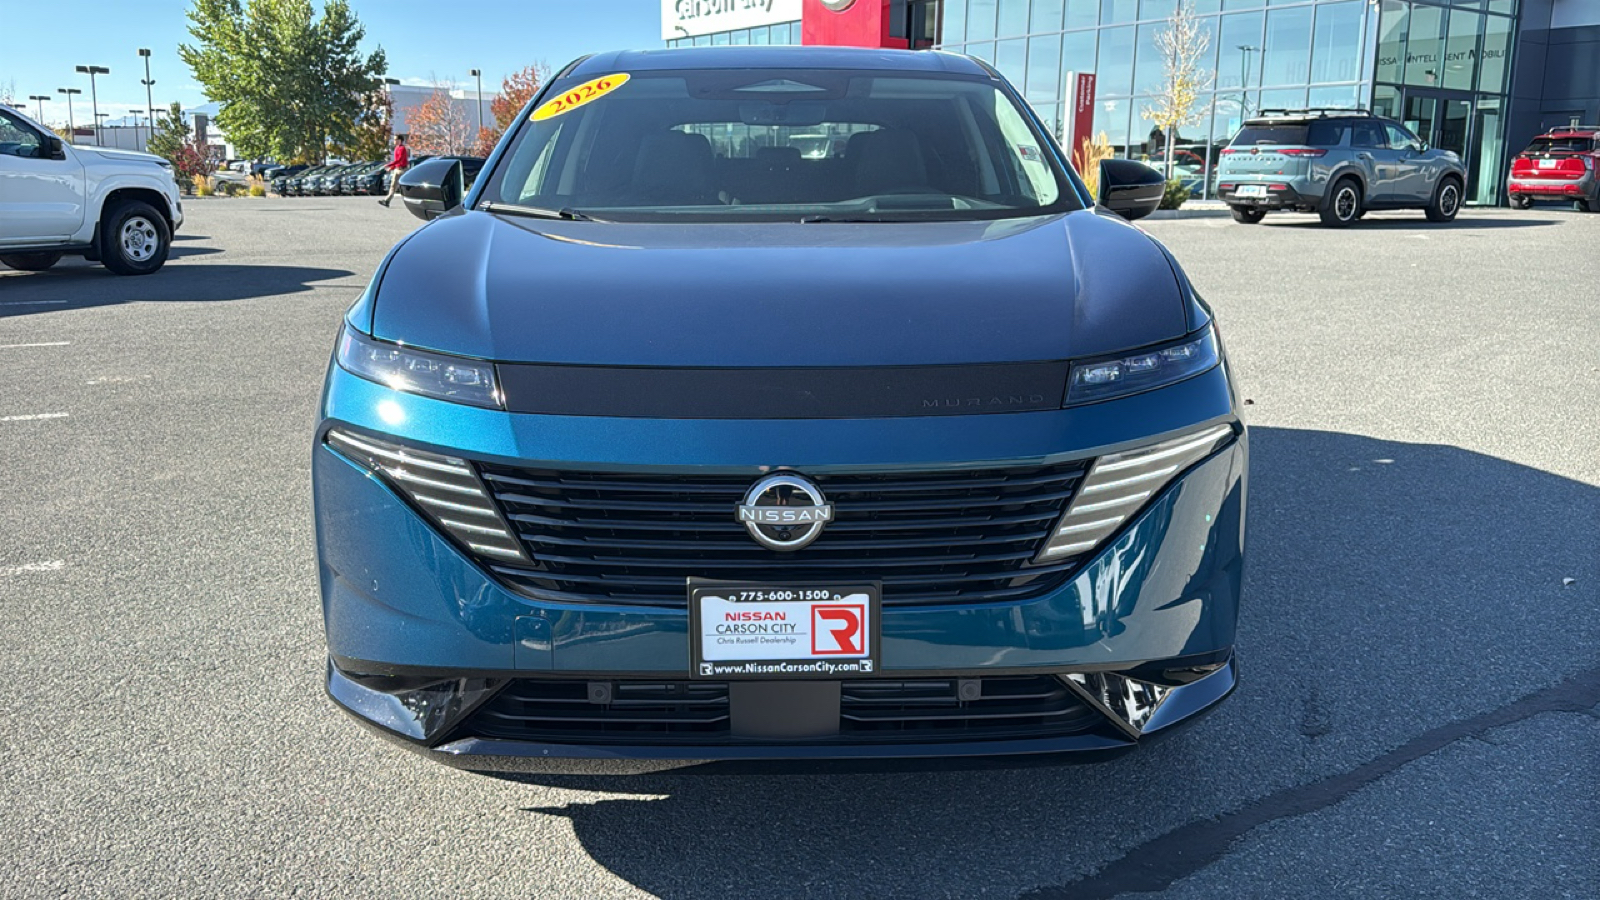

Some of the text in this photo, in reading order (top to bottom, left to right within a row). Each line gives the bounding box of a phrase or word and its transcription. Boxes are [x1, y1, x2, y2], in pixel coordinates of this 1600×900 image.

[1379, 56, 1397, 65] ISSA
[550, 79, 611, 113] 2026
[1085, 75, 1094, 106] Parking
[923, 394, 1044, 407] MURANO
[741, 508, 828, 522] NISSAN
[740, 590, 830, 601] 775-600-1500
[725, 611, 786, 621] NISSAN
[716, 623, 797, 634] CARSON CITY
[717, 636, 797, 645] Chris Russell Dealership
[714, 660, 859, 675] www.NissanCarsonCity.com
